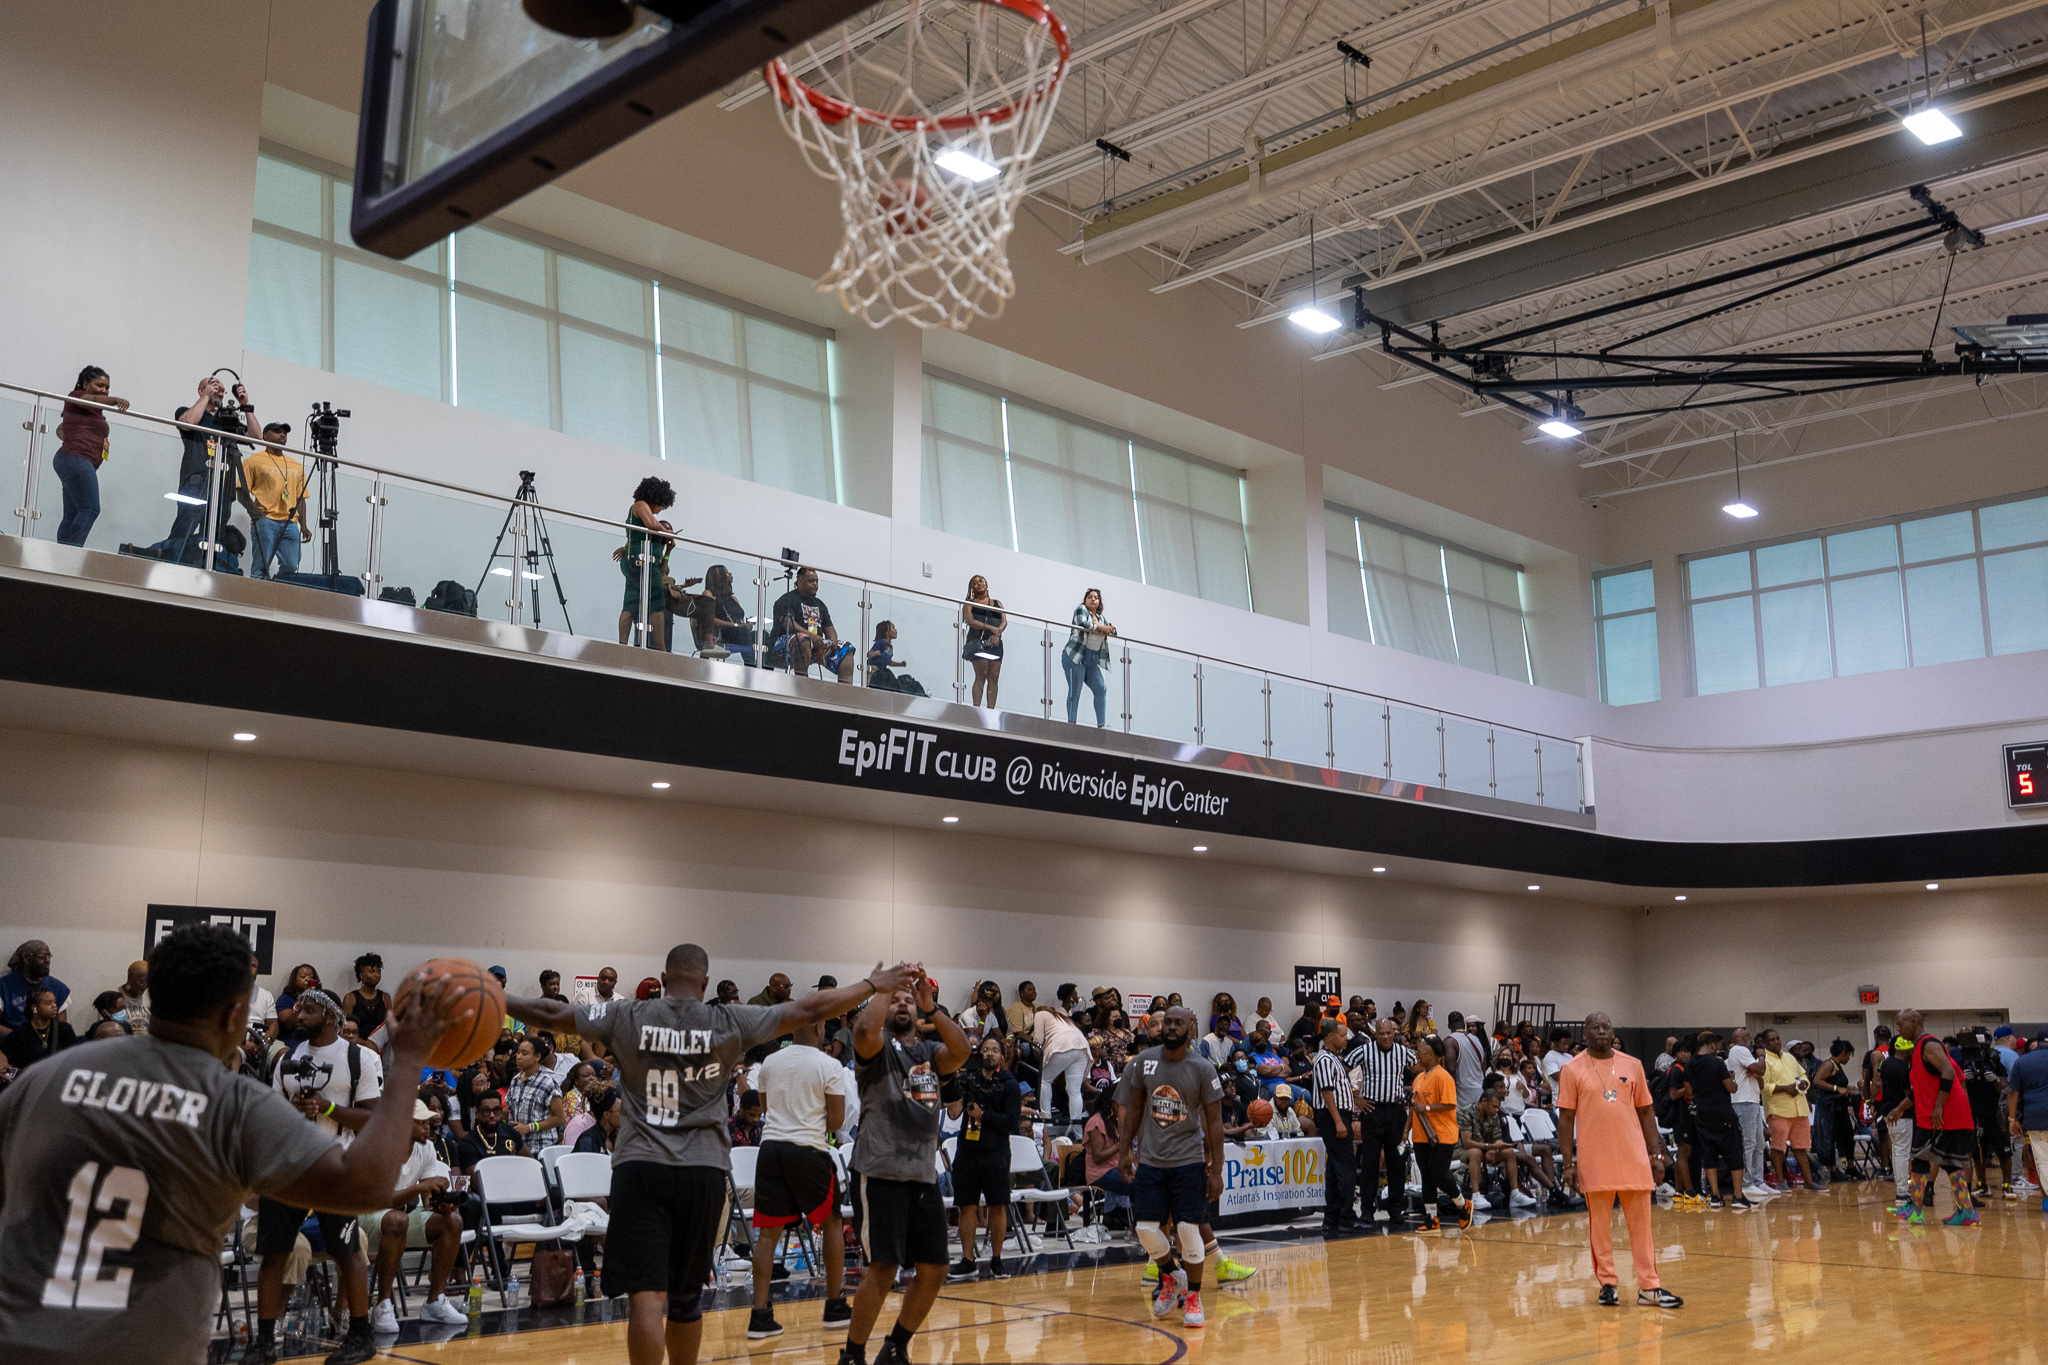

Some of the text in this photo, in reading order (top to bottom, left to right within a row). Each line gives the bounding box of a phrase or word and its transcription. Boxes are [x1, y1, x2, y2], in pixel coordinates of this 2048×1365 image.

[838, 727, 1229, 816] EpiFIT CLUB @ Riverside EpiCenter
[2018, 771, 2034, 796] 5
[1297, 970, 1338, 998] EpiFIT
[1861, 991, 1877, 1004] EXIT
[638, 1024, 713, 1055] FINDLEY
[683, 1062, 721, 1082] 1/2
[1143, 1059, 1159, 1076] 27
[60, 1068, 209, 1129] GLOVER
[1225, 1148, 1328, 1191] Praise 102.
[1226, 1190, 1261, 1206] Atlanta's
[1306, 1186, 1326, 1199] Stati
[40, 1160, 150, 1310] 12
